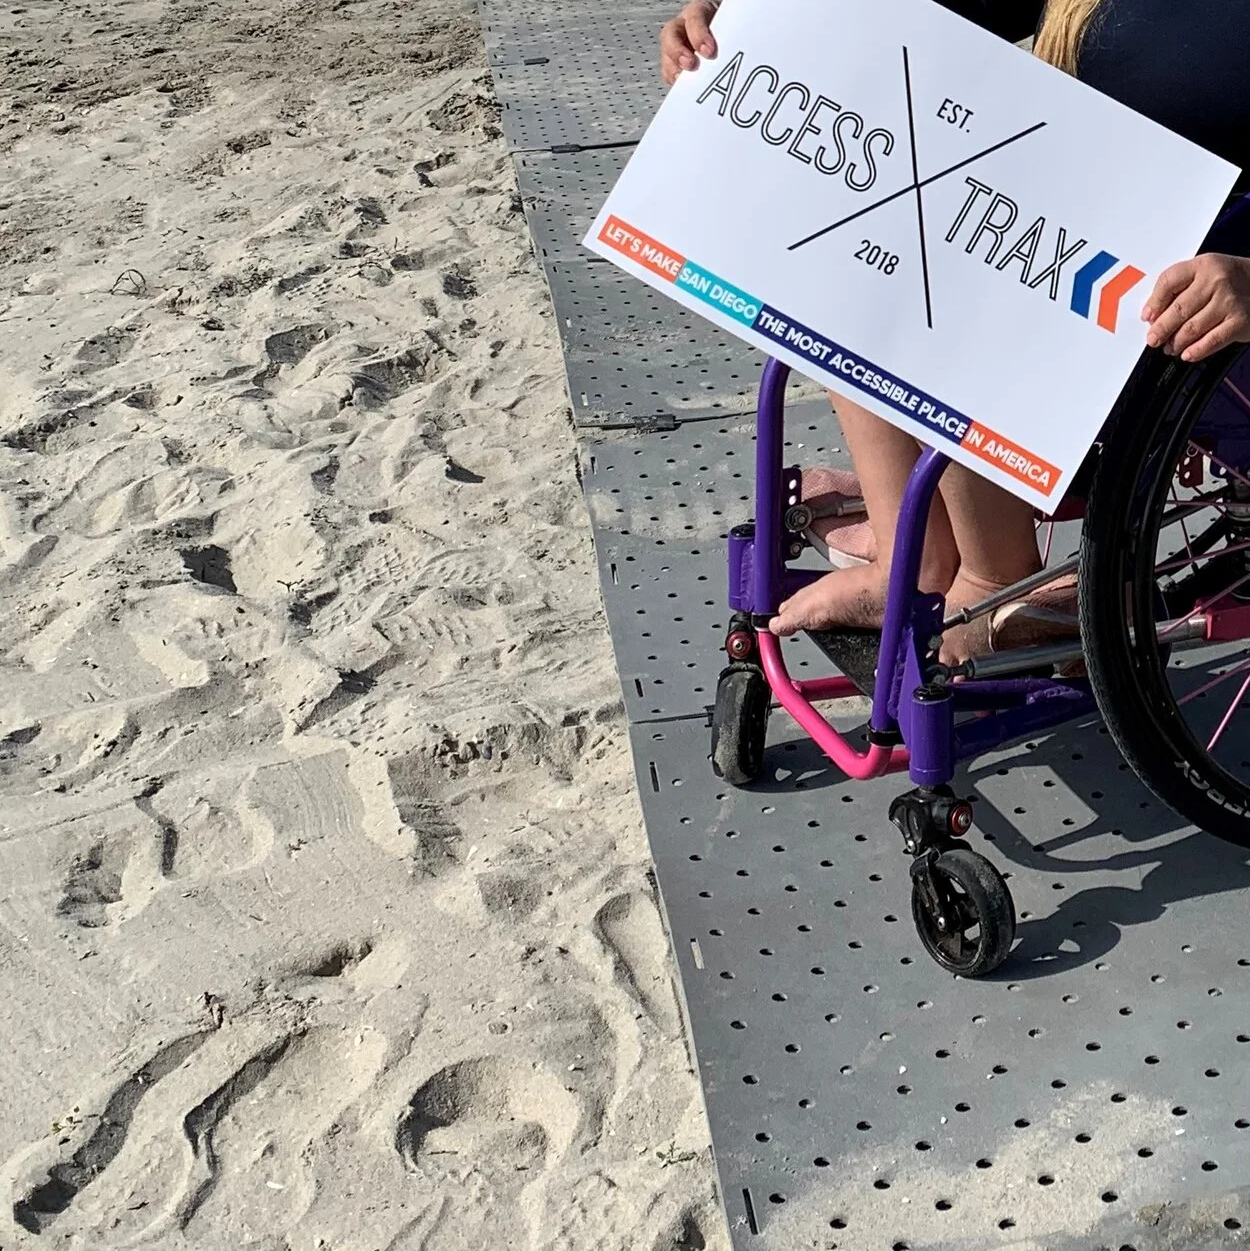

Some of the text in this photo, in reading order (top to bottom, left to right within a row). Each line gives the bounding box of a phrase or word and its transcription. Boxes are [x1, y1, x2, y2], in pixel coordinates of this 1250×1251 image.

[696, 51, 895, 192] ACCESS
[936, 98, 974, 133] EST.
[853, 239, 899, 275] 2018
[945, 176, 1088, 301] TRAX
[605, 223, 1051, 487] LET'S MAKE SAN DIEGO THE MOST ACCESSIBLE PLACE IN AMERICA
